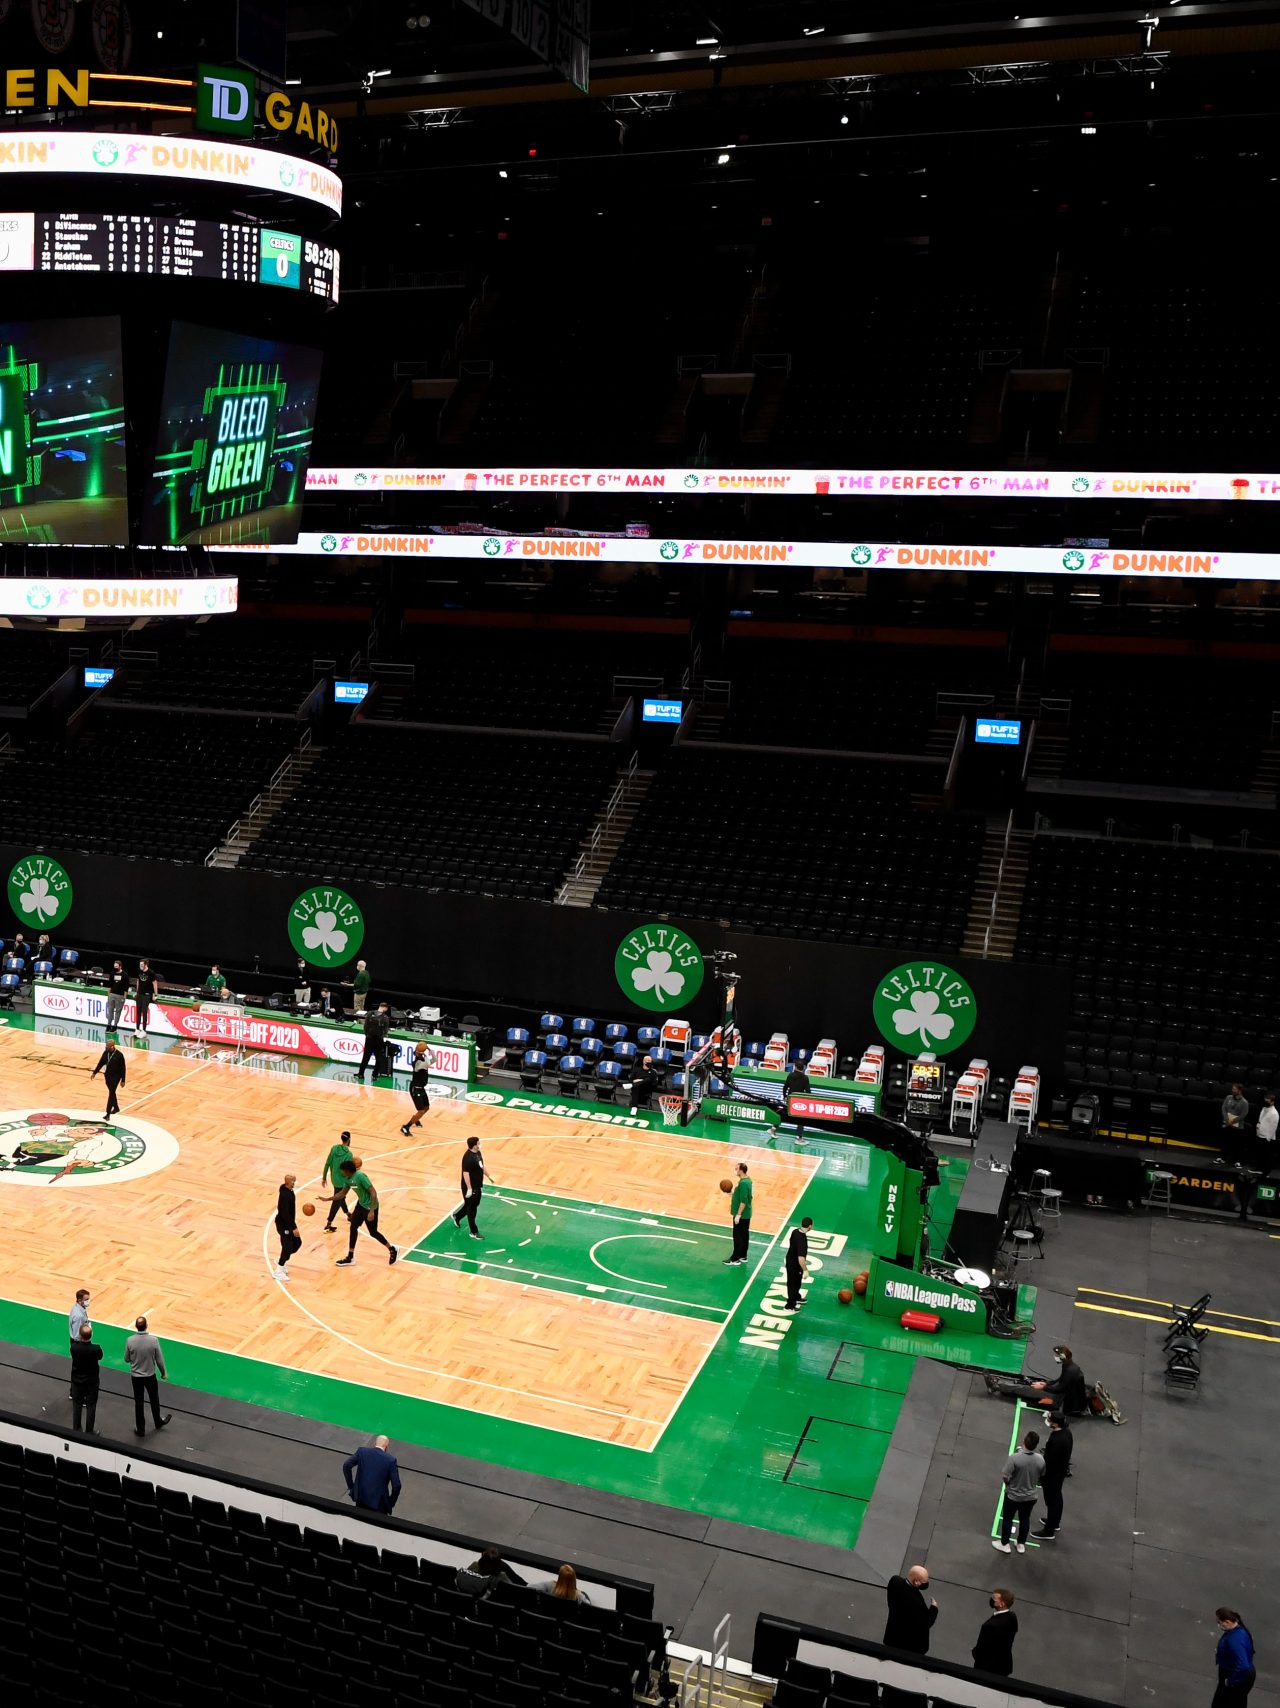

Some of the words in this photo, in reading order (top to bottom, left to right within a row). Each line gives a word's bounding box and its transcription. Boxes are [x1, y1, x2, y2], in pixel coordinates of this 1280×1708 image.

[204, 77, 249, 121] TD
[265, 92, 338, 153] GARD
[152, 145, 256, 177] DUNKIN'
[41, 252, 50, 260] 22
[270, 237, 295, 251] CELTICS
[305, 240, 334, 271] 58:23
[41, 262, 51, 270] 34
[276, 253, 289, 278] 0
[220, 395, 269, 443] BLEED
[207, 441, 266, 494] GREEN
[306, 473, 338, 485] MAN
[383, 474, 446, 486] DUNKIN'
[484, 473, 515, 485] THE
[519, 474, 592, 486] PERFECT
[596, 474, 621, 486] 6TH
[625, 475, 666, 487] MAN
[718, 475, 791, 488] DUNKIN'
[837, 476, 874, 489] THE
[879, 476, 963, 490] PERFECT
[969, 477, 997, 490] 6TH
[1003, 478, 1049, 490] MAN
[1112, 480, 1197, 493] DUNKIN'
[357, 535, 435, 552] DUNKIN'
[522, 540, 606, 557] DUNKIN'
[702, 544, 793, 561] DUNKIN'
[897, 548, 996, 567] DUNKIN'
[1112, 554, 1219, 573] DUNKIN'
[82, 587, 184, 608] DUNKIN'
[657, 705, 680, 714] TUFTS
[991, 725, 1019, 734] TUFTS
[11, 859, 68, 891] CELTICS
[294, 891, 360, 926] CELTICS
[622, 928, 699, 967] CELTICS
[881, 967, 970, 1009] CELTICS
[187, 1018, 207, 1029] KIA
[230, 1019, 269, 1045] TIP-OFF
[269, 1025, 300, 1048] 2020
[913, 1065, 940, 1078] 58:23
[919, 1092, 941, 1100] TISSOT
[506, 1098, 650, 1128] Putnam
[715, 1104, 765, 1121] #BLEEDGREEN
[93, 1134, 144, 1171] CELTICS
[1168, 1175, 1235, 1193] GARDEN
[886, 1185, 898, 1213] NBA
[884, 1215, 894, 1233] TV
[894, 1281, 914, 1302] NBA
[914, 1284, 951, 1309] League
[951, 1293, 977, 1313] Pass
